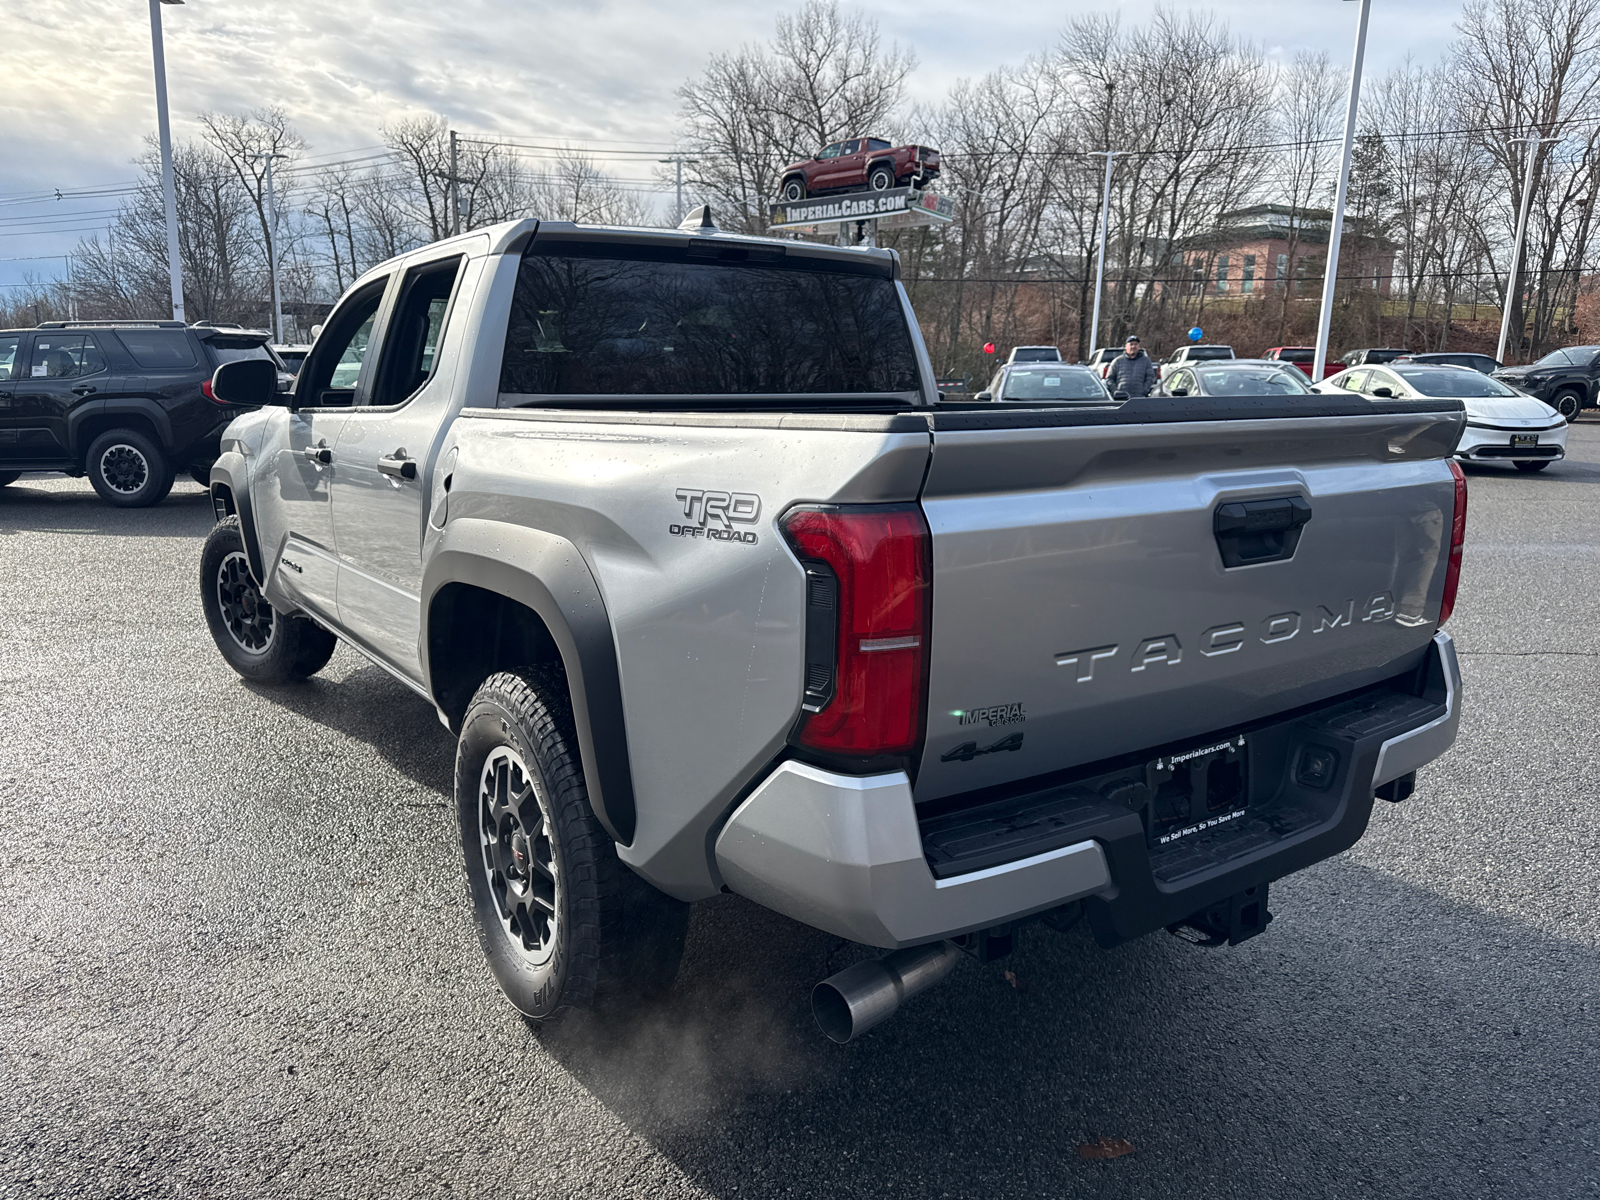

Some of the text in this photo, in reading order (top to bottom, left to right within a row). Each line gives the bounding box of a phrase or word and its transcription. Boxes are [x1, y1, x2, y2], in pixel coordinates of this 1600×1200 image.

[675, 488, 762, 531] TRD
[1247, 509, 1290, 526] TOYOTA
[669, 524, 758, 545] OFF ROAD
[1053, 590, 1395, 682] TACOMA
[960, 702, 1027, 725] IMPERIAL
[989, 714, 1027, 727] cars.com
[1170, 741, 1231, 764] Imperialcars.com
[1160, 809, 1246, 845] We Sell More, So You Save More
